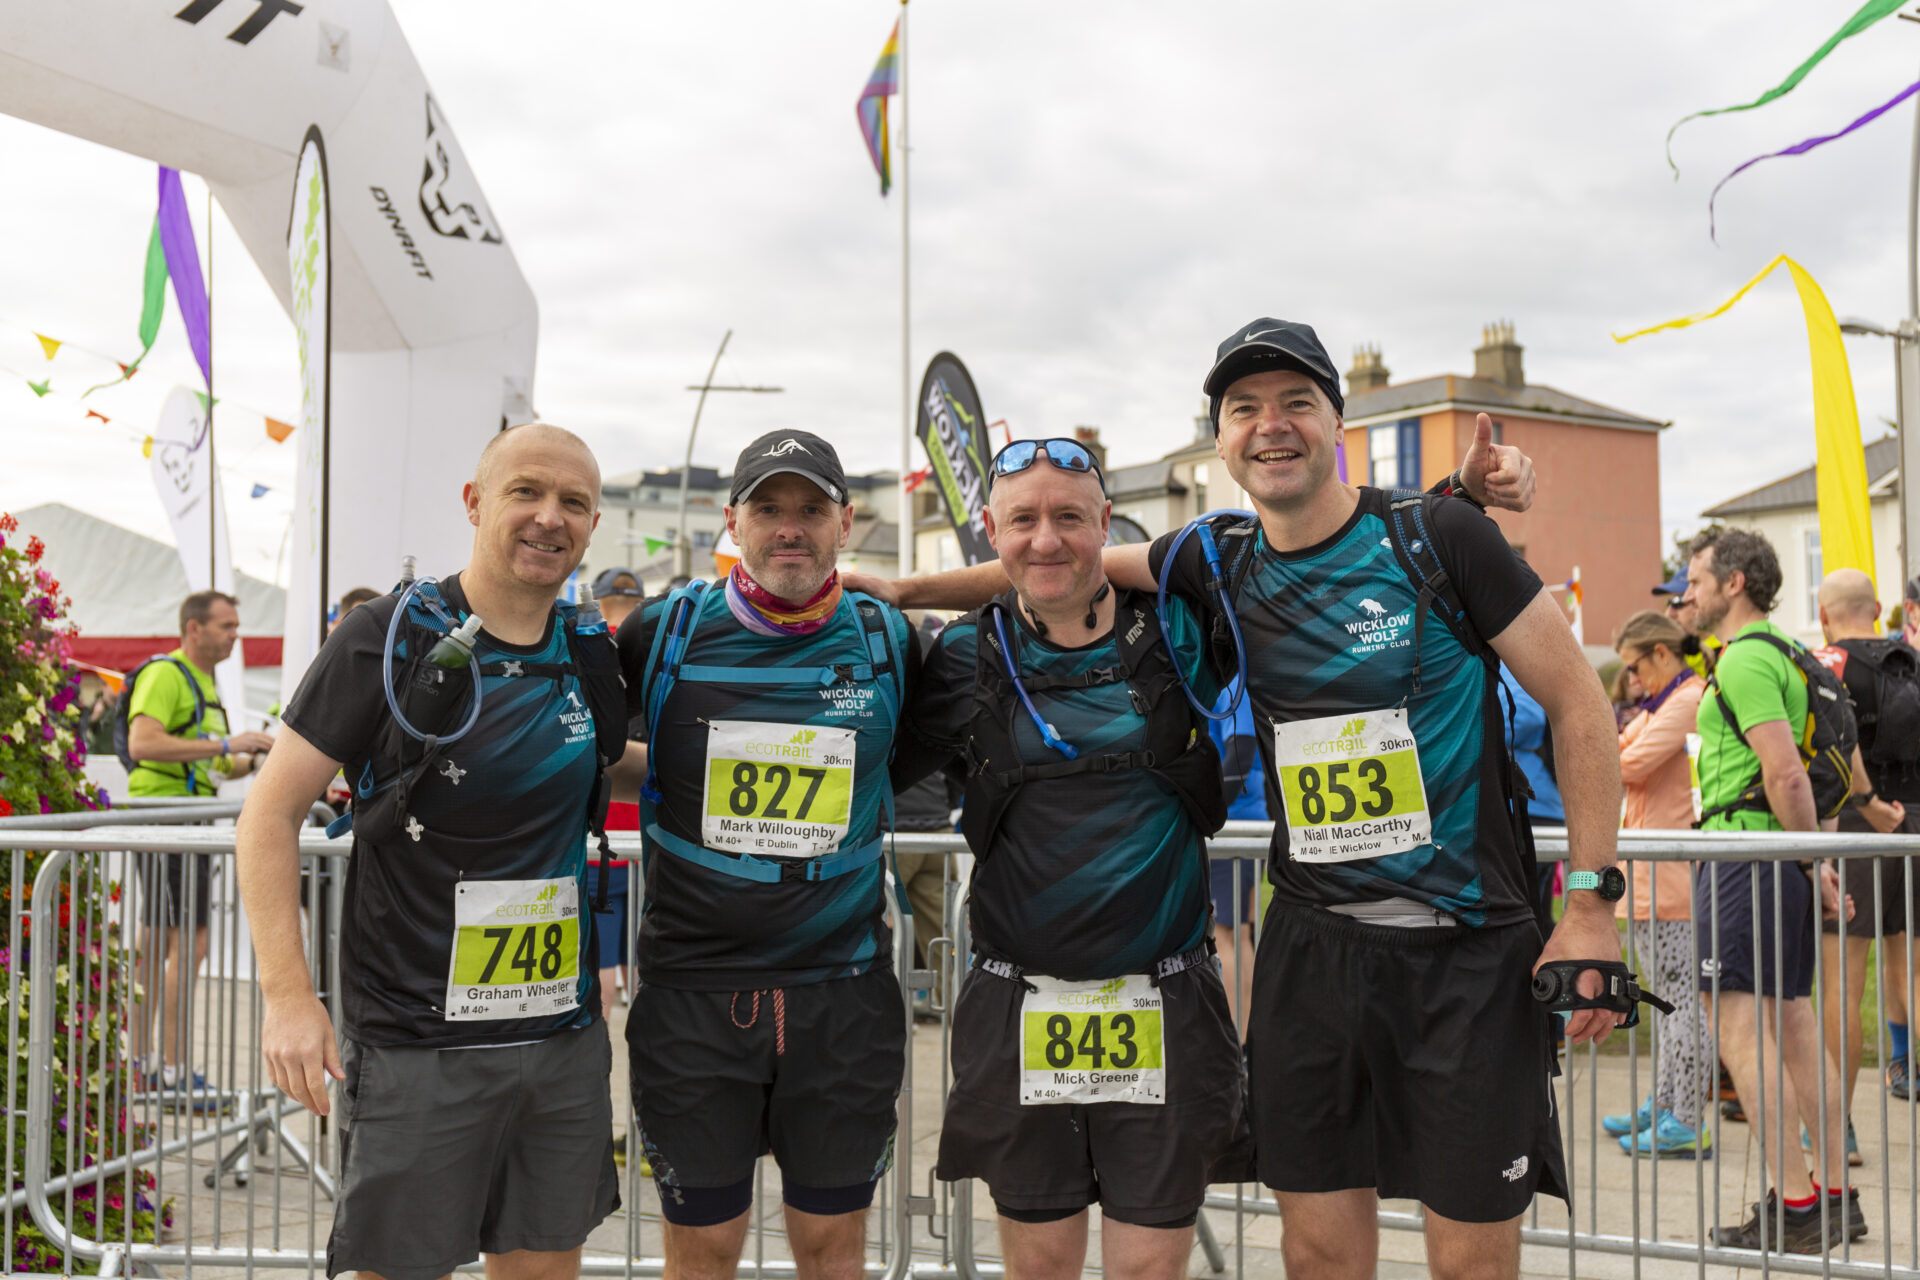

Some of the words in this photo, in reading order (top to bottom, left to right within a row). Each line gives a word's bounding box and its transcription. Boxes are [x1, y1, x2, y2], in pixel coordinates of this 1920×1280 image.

[369, 186, 433, 281] DYNAFIT
[1344, 613, 1411, 635] WICKLOW
[1359, 628, 1399, 645] WOLF
[1352, 643, 1385, 653] RUNNING
[1390, 639, 1411, 648] CLUB
[818, 688, 874, 700] WICKLOW
[833, 699, 867, 710] WOLF
[1380, 738, 1413, 751] 30km
[823, 755, 852, 766] 30km
[729, 761, 827, 820] 827
[1298, 758, 1394, 824] 853
[720, 819, 753, 833] Mark
[758, 821, 836, 840] Willoughby
[1304, 829, 1328, 842] Niall
[1331, 818, 1412, 839] MacCarthy
[715, 836, 723, 844] M
[725, 836, 742, 845] 40+
[755, 839, 764, 847] IE
[768, 839, 798, 849] Dublin
[1300, 847, 1307, 855] M
[1309, 847, 1322, 855] 40+
[1329, 846, 1337, 854] IE
[1340, 841, 1381, 853] Wicklow
[1412, 833, 1421, 841] M
[562, 907, 577, 917] 30km
[477, 923, 562, 983] 748
[467, 987, 522, 1000] Graham
[527, 981, 570, 997] Wheeler
[460, 1006, 469, 1014] M
[472, 1005, 489, 1014] 40+
[519, 1003, 527, 1012] IE
[1132, 998, 1160, 1008] 30km
[1045, 1013, 1138, 1069] 843
[1054, 1072, 1086, 1084] Mick
[1090, 1072, 1139, 1084] Greene
[1034, 1090, 1042, 1098] M
[1044, 1089, 1061, 1098] 40+
[1090, 1088, 1099, 1096] IE
[1131, 1088, 1137, 1096] T
